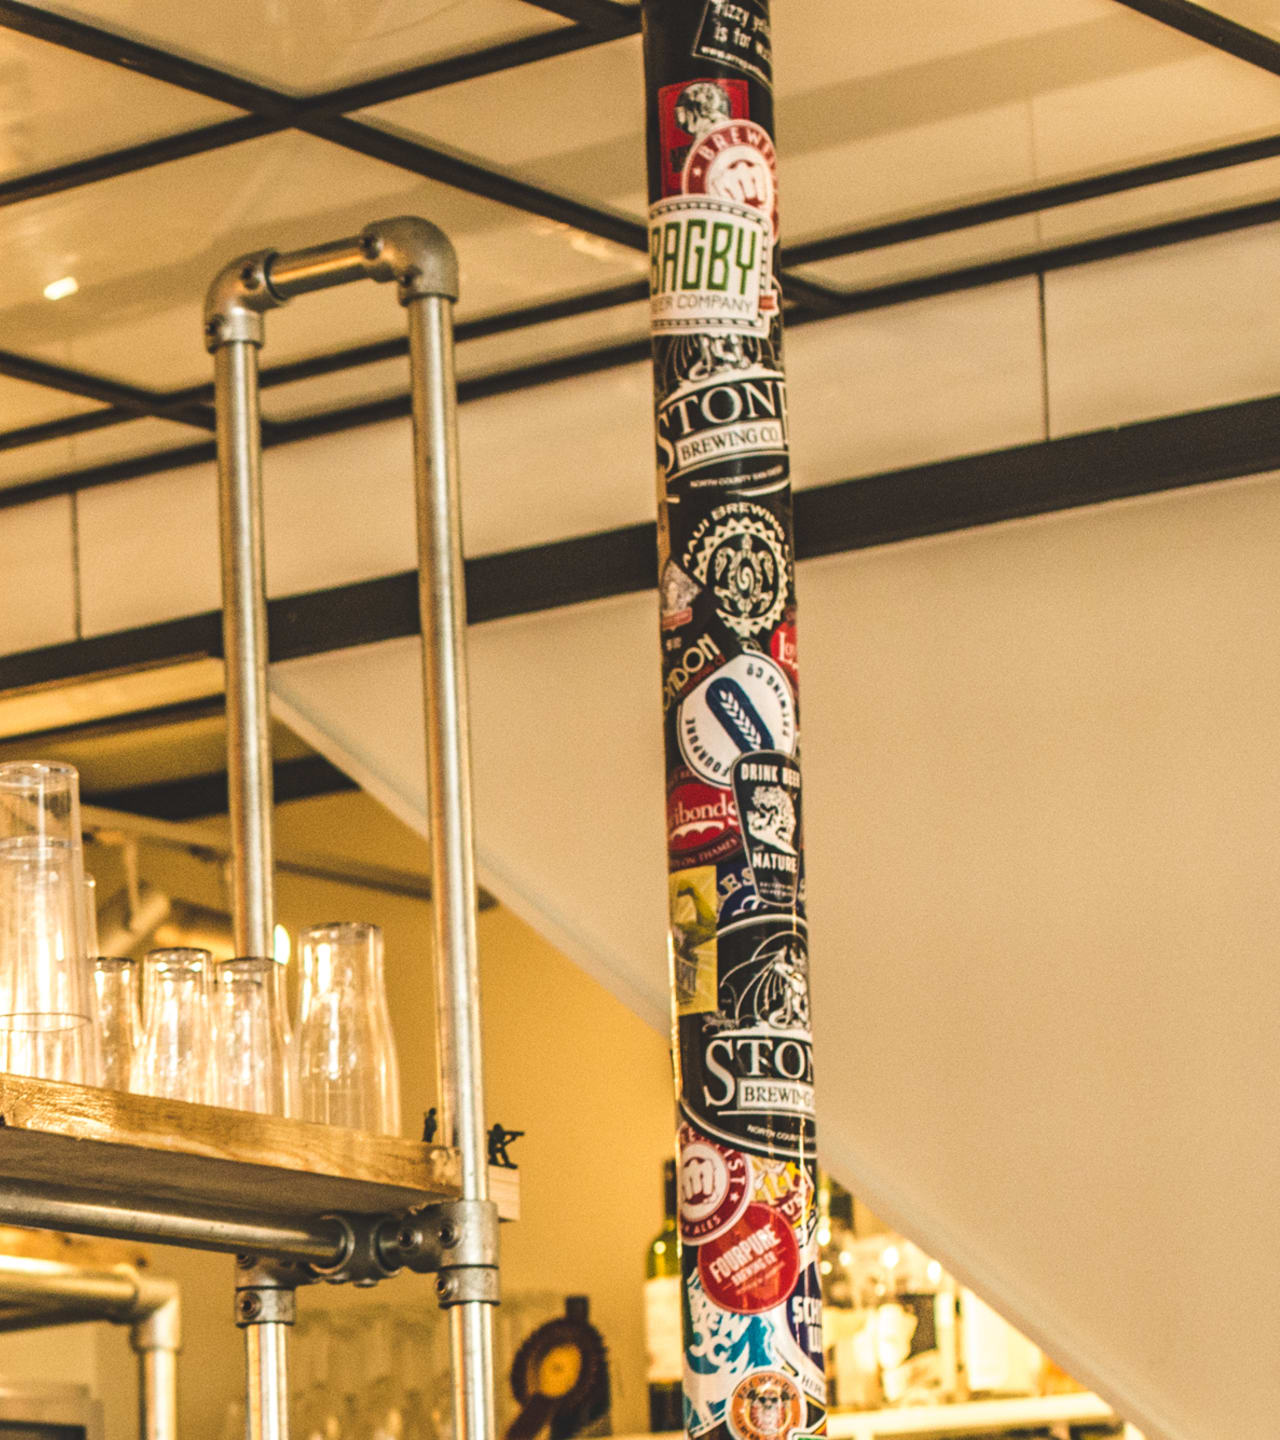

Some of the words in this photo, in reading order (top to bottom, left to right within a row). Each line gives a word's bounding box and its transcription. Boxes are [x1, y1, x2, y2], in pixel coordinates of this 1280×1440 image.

[677, 294, 753, 312] COMPANY
[681, 428, 757, 461] BREWING
[740, 763, 778, 782] DRINK
[752, 851, 798, 873] NATURE
[709, 1223, 781, 1284] FOURPURE
